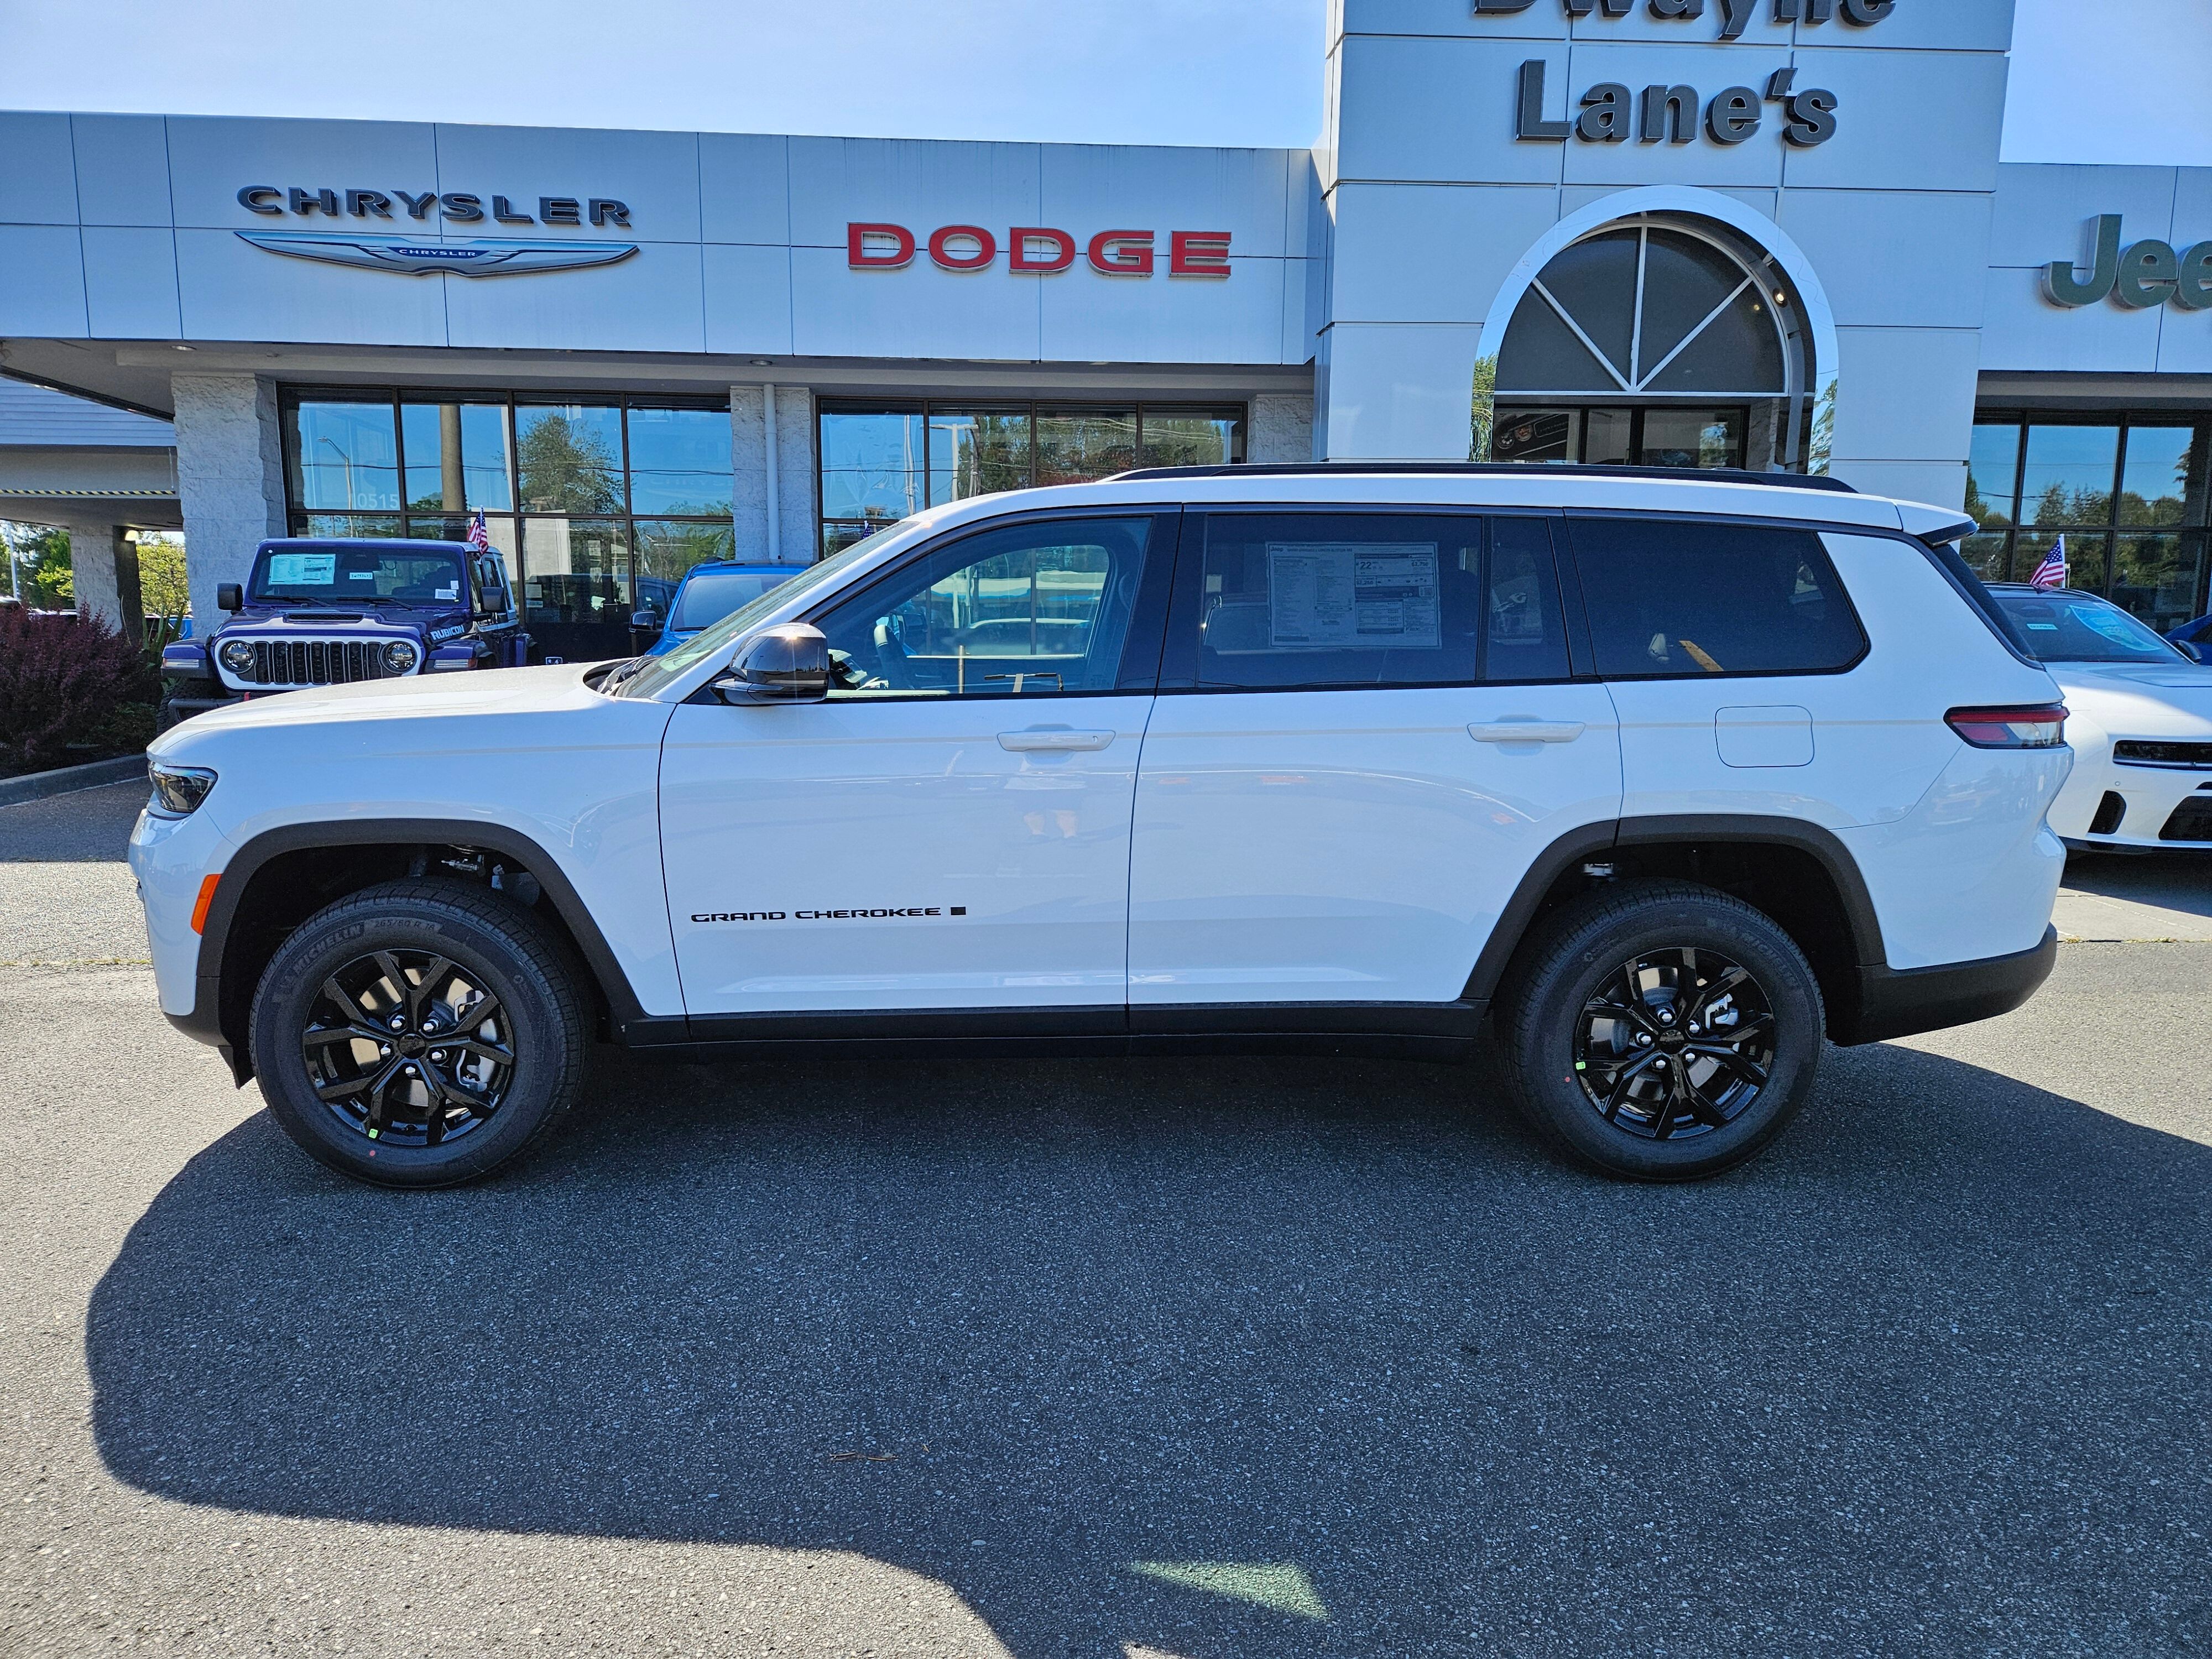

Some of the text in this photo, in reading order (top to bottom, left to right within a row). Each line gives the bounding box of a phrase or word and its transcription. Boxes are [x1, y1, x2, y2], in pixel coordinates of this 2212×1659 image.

[1515, 59, 1838, 147] Lane's
[236, 185, 632, 227] CHRYSLER
[847, 222, 1232, 278] DODGE
[430, 624, 465, 640] RUBICON
[691, 907, 941, 922] GRAND CHEROKEE
